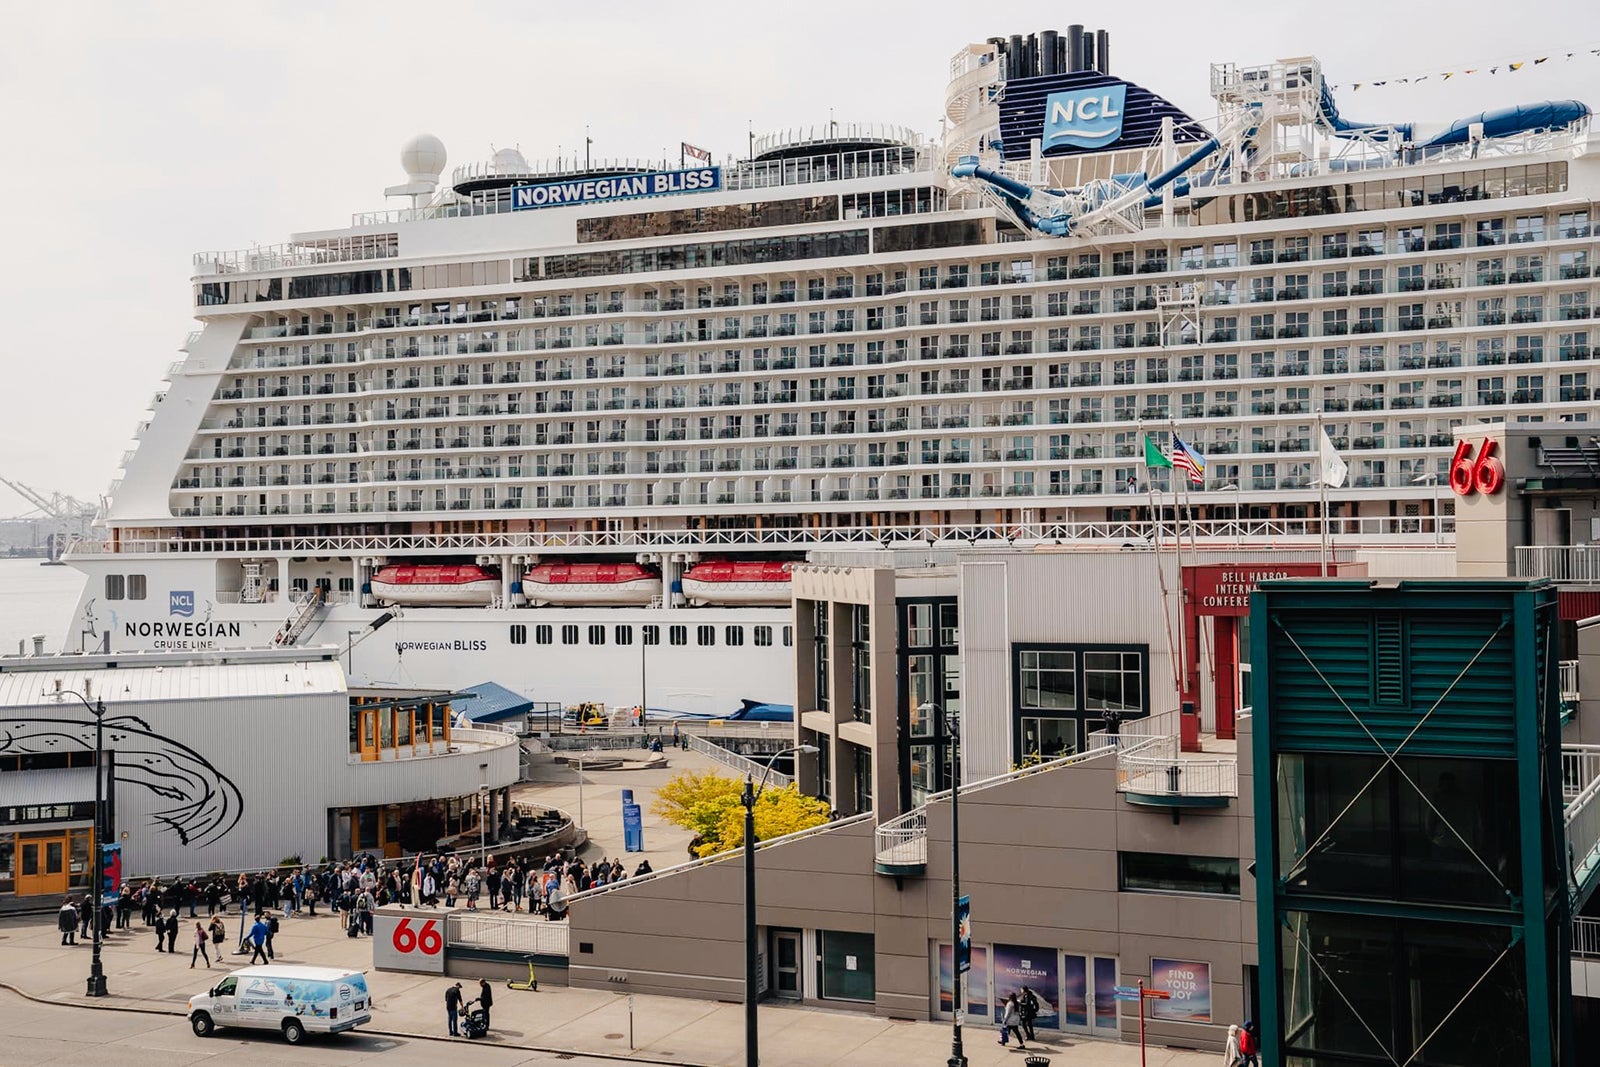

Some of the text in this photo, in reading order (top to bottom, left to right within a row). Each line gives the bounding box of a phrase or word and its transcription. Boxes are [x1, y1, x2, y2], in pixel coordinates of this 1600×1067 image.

[1051, 95, 1119, 125] NCL
[518, 169, 714, 206] NORWEGIAN BLISS
[1449, 436, 1505, 496] 66
[1222, 571, 1288, 582] BELL HARBOR
[1215, 584, 1260, 594] INTERNA
[171, 596, 192, 606] NCL
[1203, 596, 1249, 607] CONFERE
[126, 622, 240, 637] NORWEGIAN
[154, 641, 213, 649] CRUISE LINE
[395, 640, 487, 651] NORWEGIAN BLISS
[392, 917, 443, 956] 66
[1006, 968, 1047, 976] NORWEGIAN
[1168, 970, 1194, 980] FIND
[1166, 979, 1197, 991] YOUR
[1170, 991, 1192, 1000] JOY
